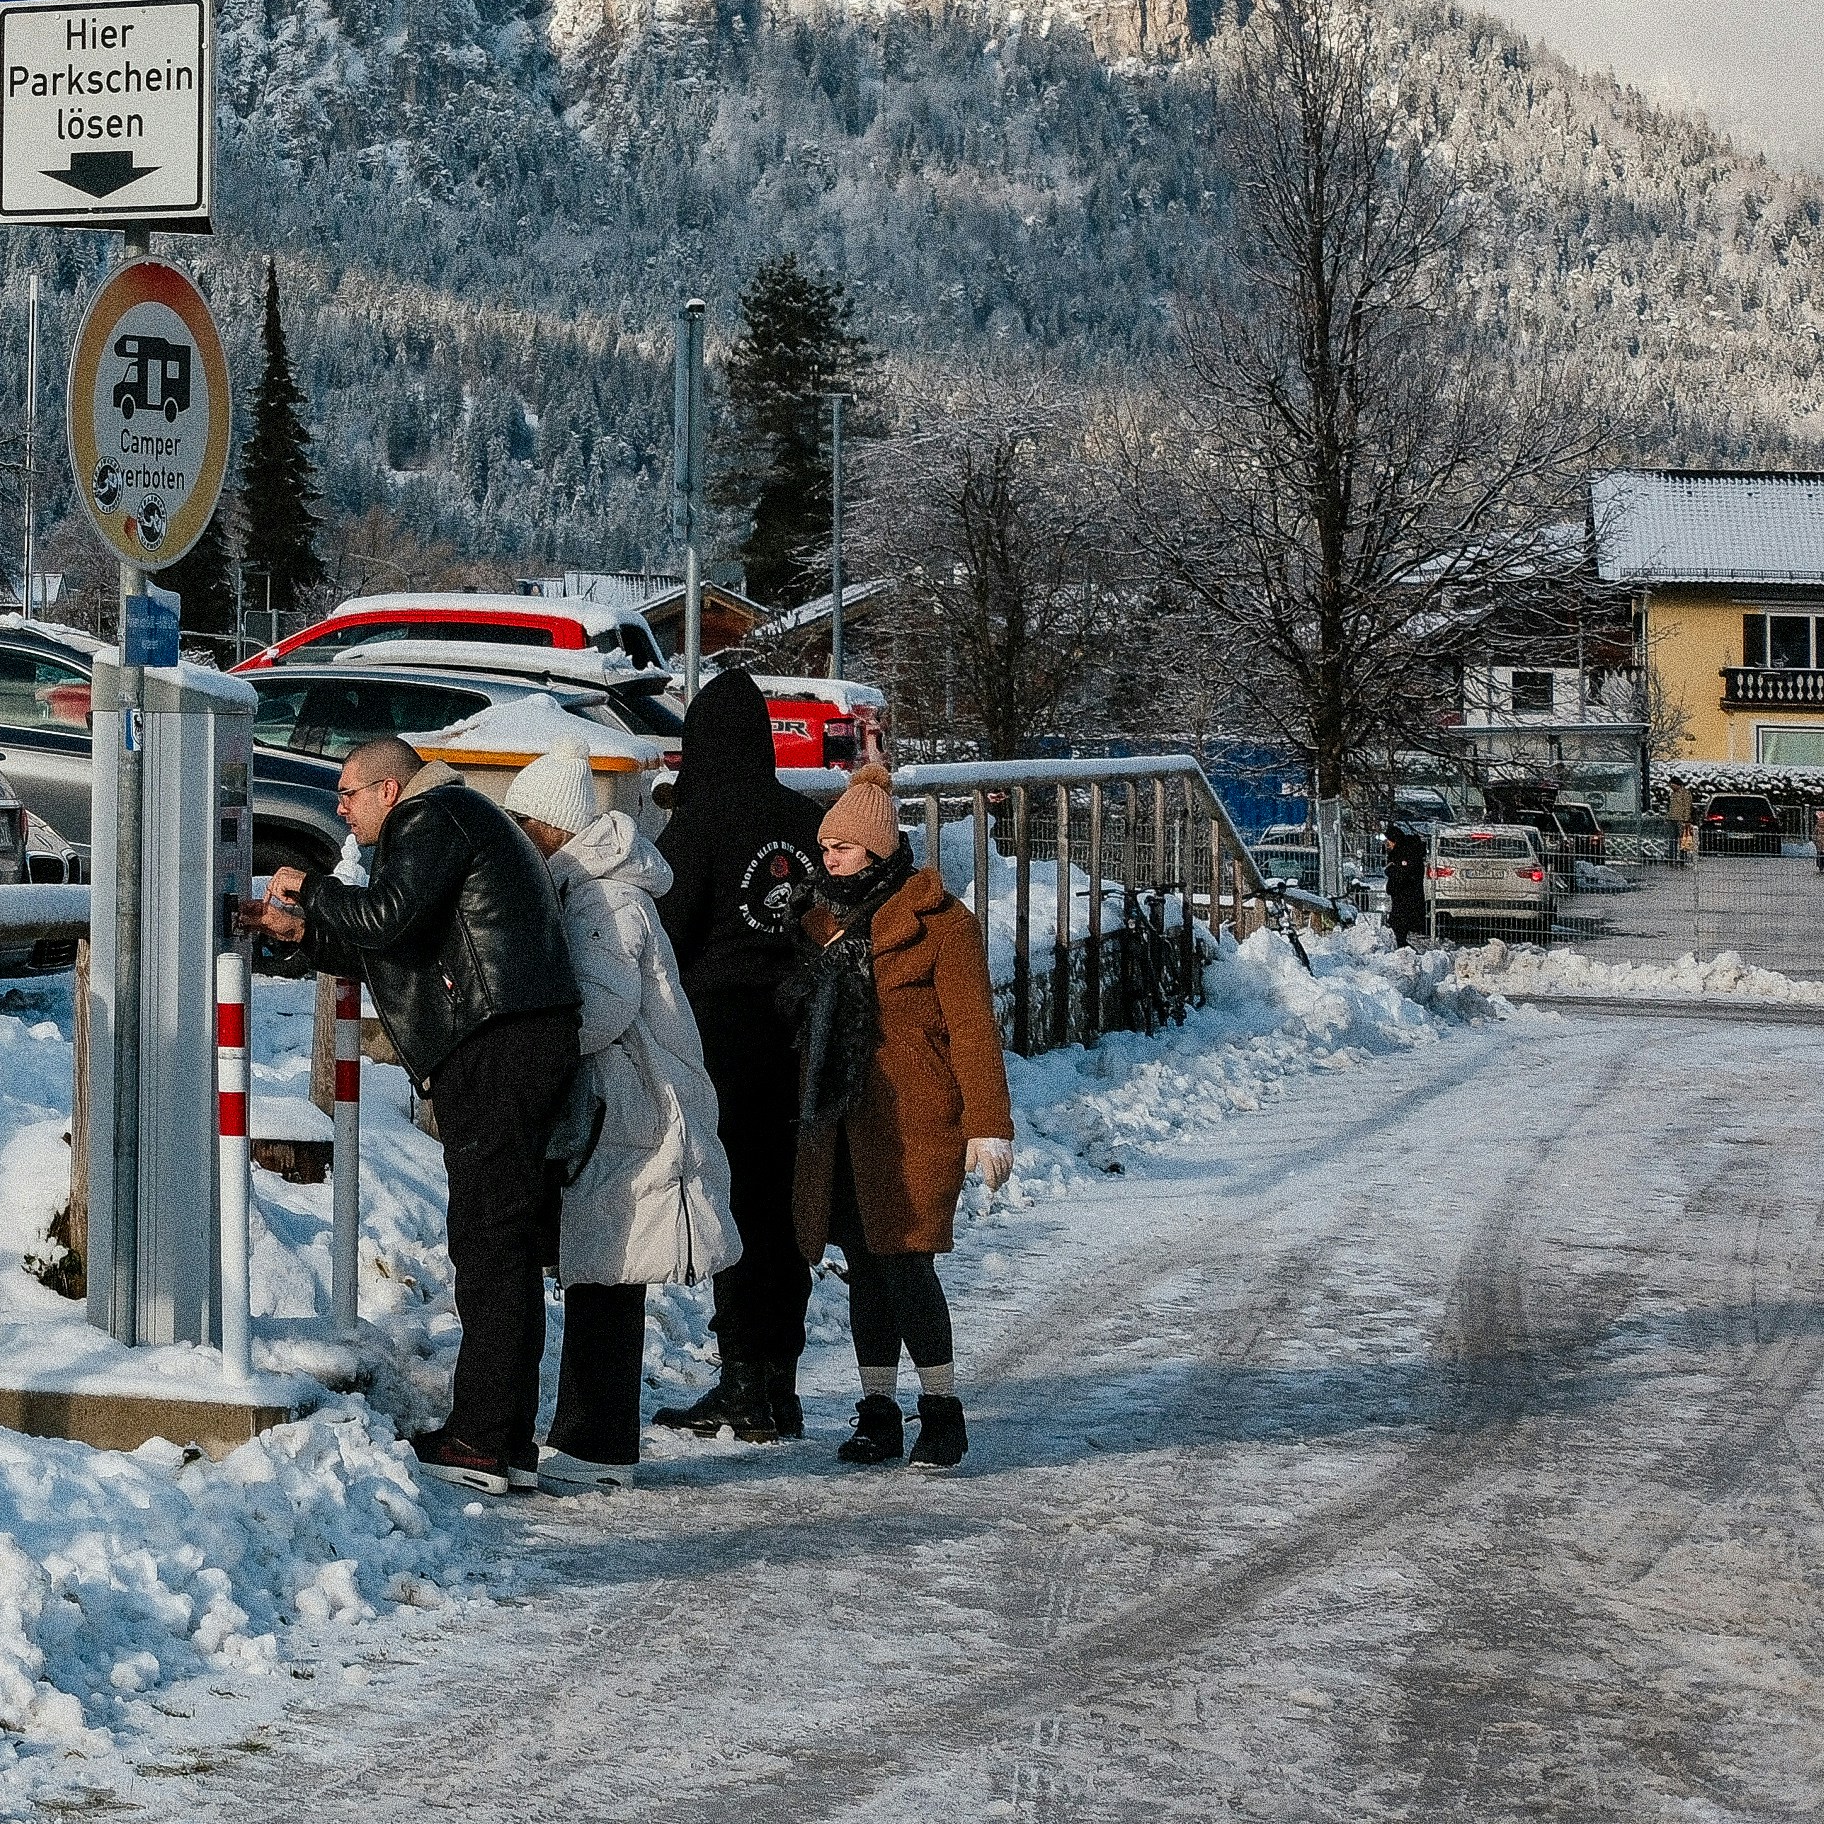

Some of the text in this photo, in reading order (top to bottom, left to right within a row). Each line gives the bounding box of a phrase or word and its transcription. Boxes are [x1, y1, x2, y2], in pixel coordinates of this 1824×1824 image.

[65, 16, 135, 51] Hier
[8, 58, 194, 98] Parkschein
[57, 107, 144, 141] lösen
[120, 428, 181, 461] Camper
[756, 841, 779, 860] KLUB
